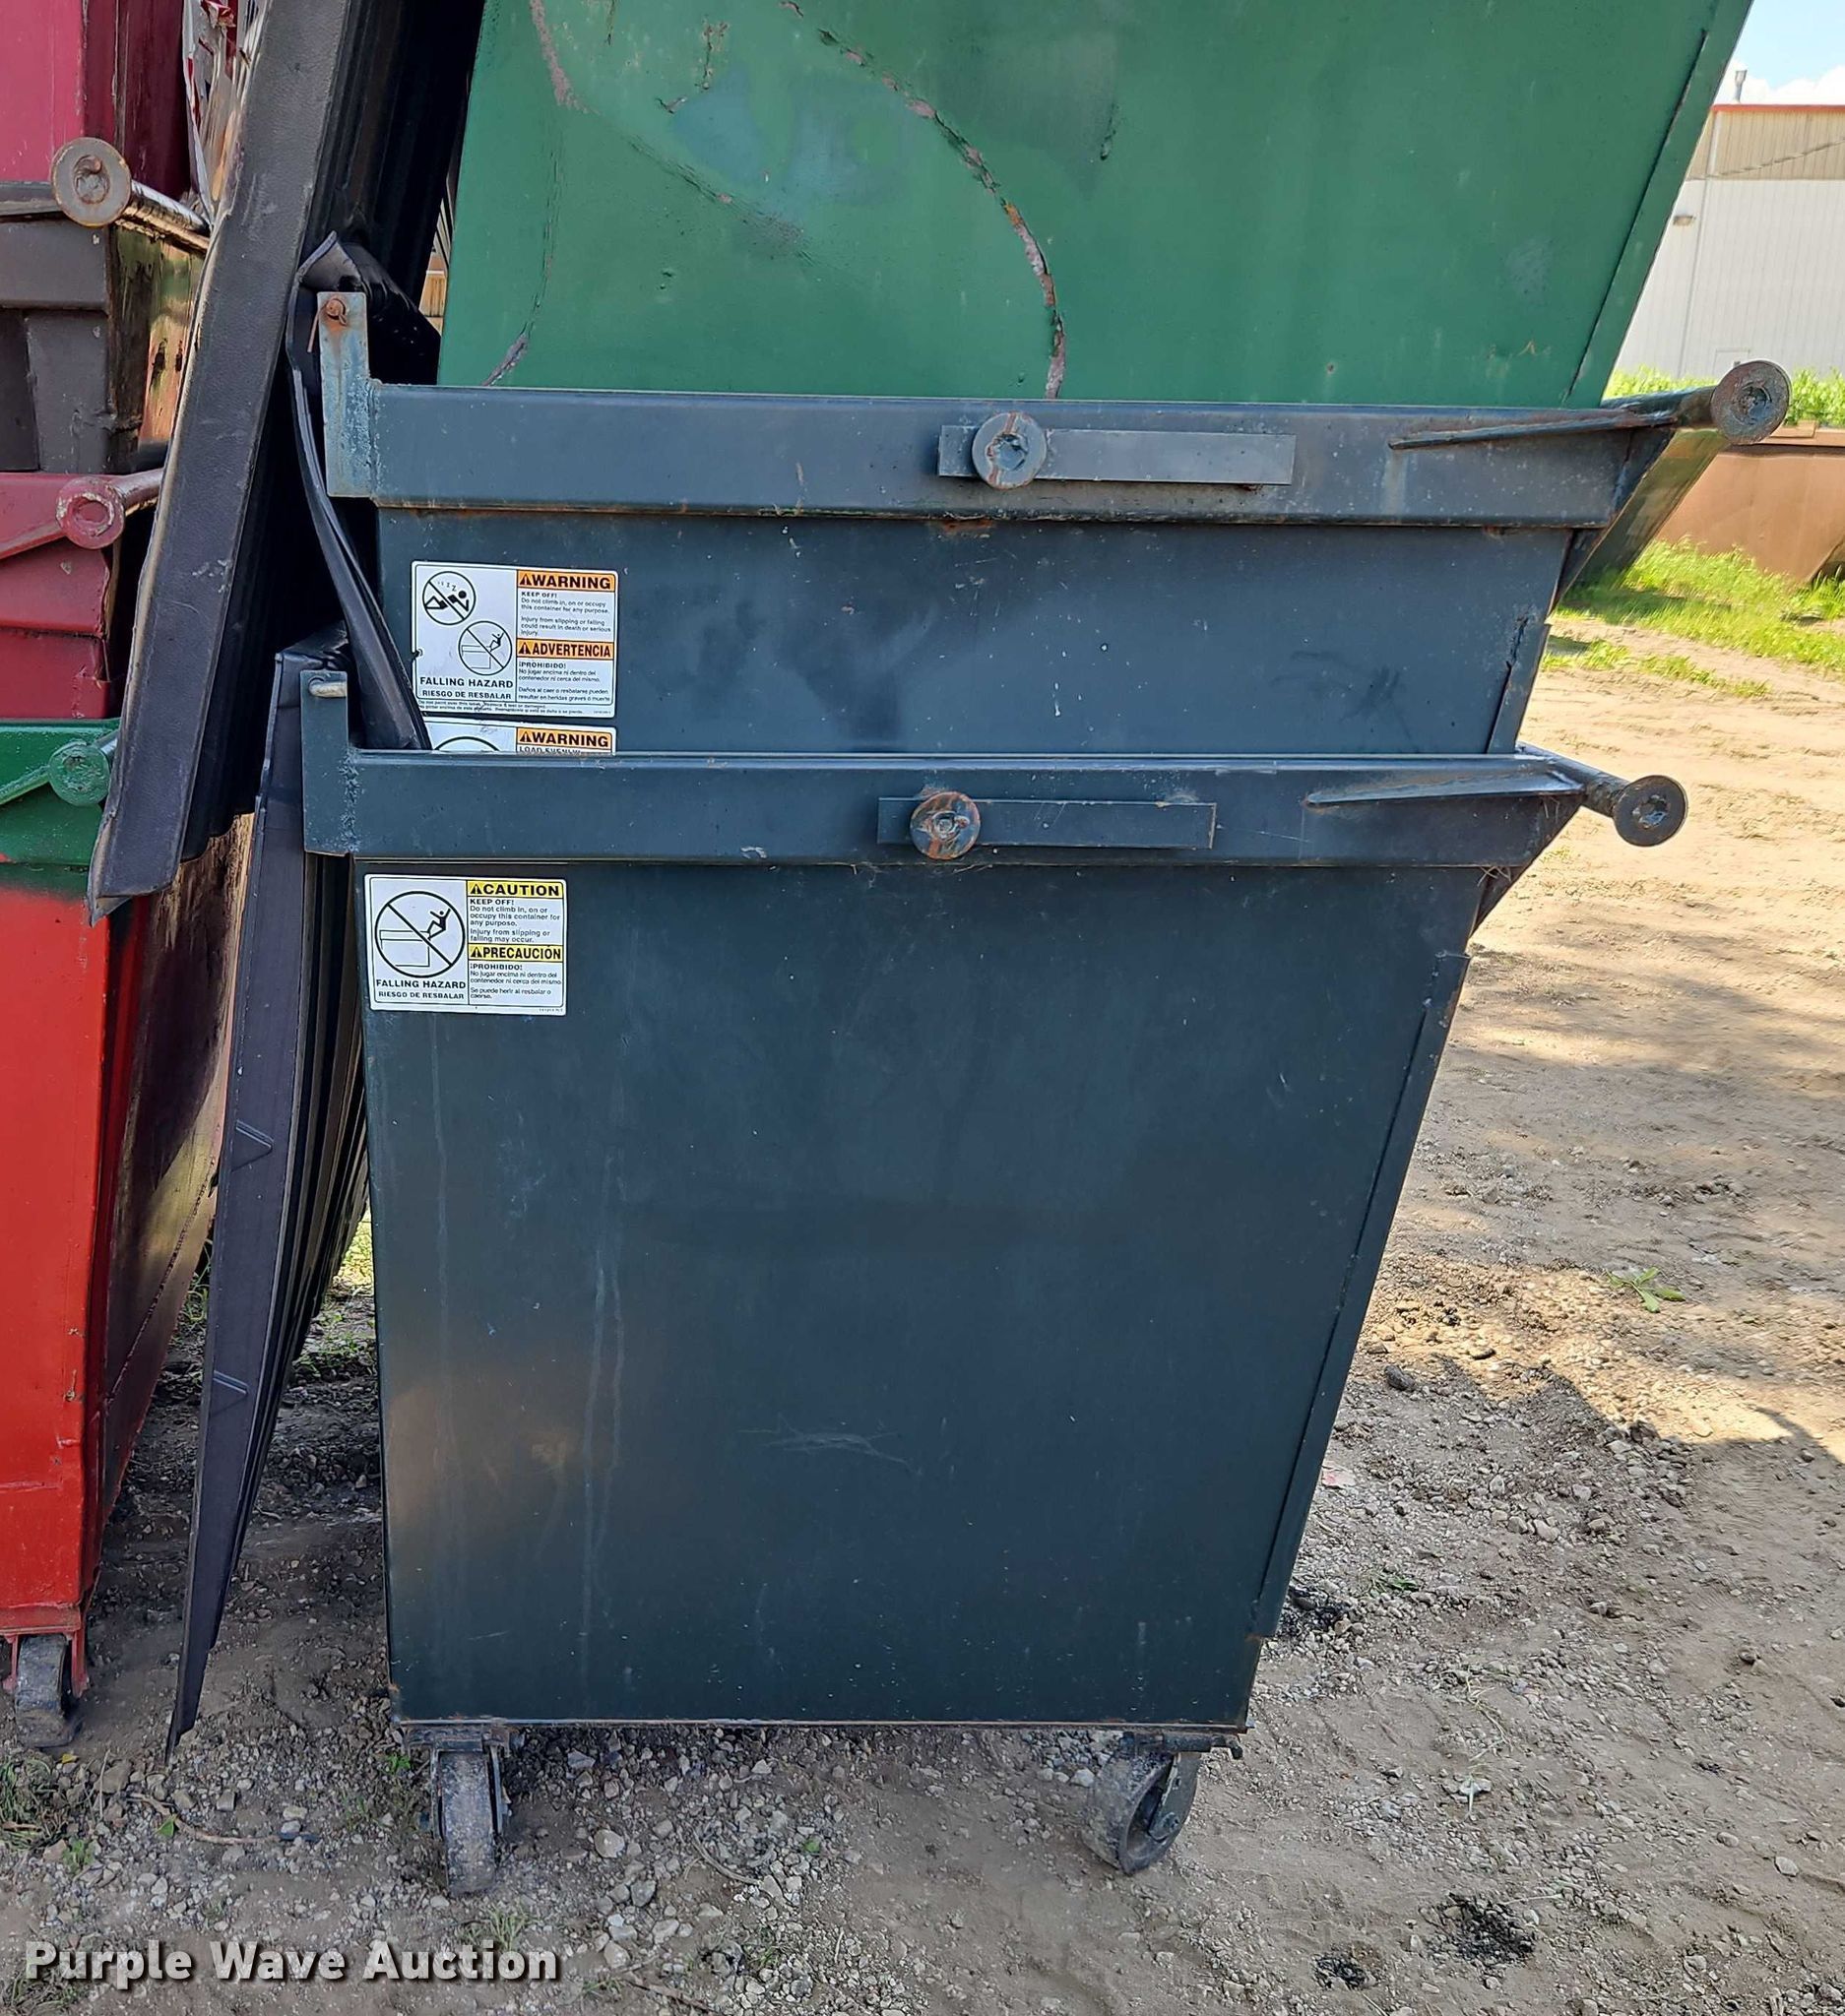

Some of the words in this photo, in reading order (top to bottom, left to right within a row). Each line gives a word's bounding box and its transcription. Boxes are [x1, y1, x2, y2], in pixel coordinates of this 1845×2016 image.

[532, 574, 610, 589] WARNING
[533, 643, 610, 657] ADVERTENCIA
[420, 677, 465, 686] FALLING
[469, 679, 513, 688] HAZARD
[532, 731, 608, 747] WARNING
[483, 884, 559, 896] CAUTION
[483, 945, 561, 959] PRECAUCIÓN
